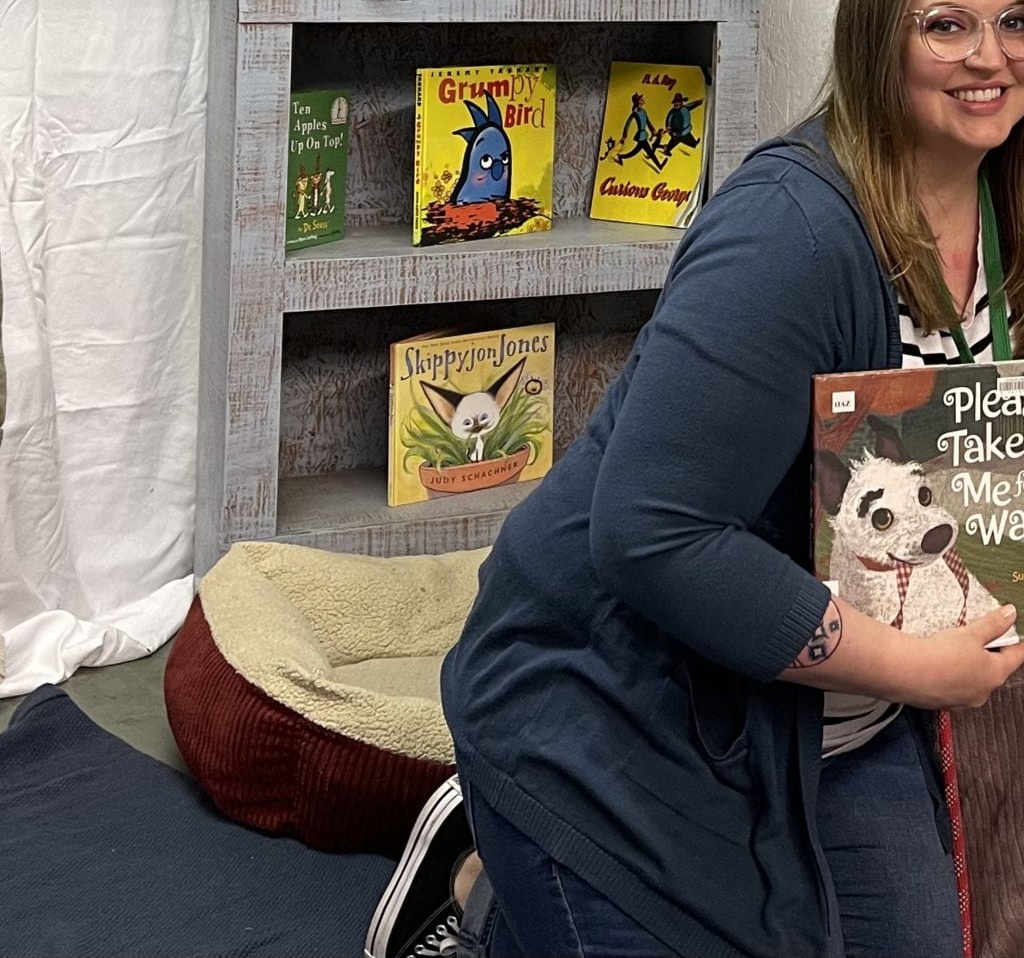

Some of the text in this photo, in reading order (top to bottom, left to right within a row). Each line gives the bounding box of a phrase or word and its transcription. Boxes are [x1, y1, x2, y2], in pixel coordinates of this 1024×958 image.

[438, 74, 540, 104] Grumpy
[292, 101, 311, 114] Ten
[504, 98, 546, 129] Bird
[293, 118, 328, 135] Apples
[290, 132, 344, 155] Up On Top!
[599, 176, 650, 199] Curious
[937, 422, 1024, 467] Take
[430, 461, 518, 484] JUDY SCHACHNER
[951, 472, 1012, 507] Me
